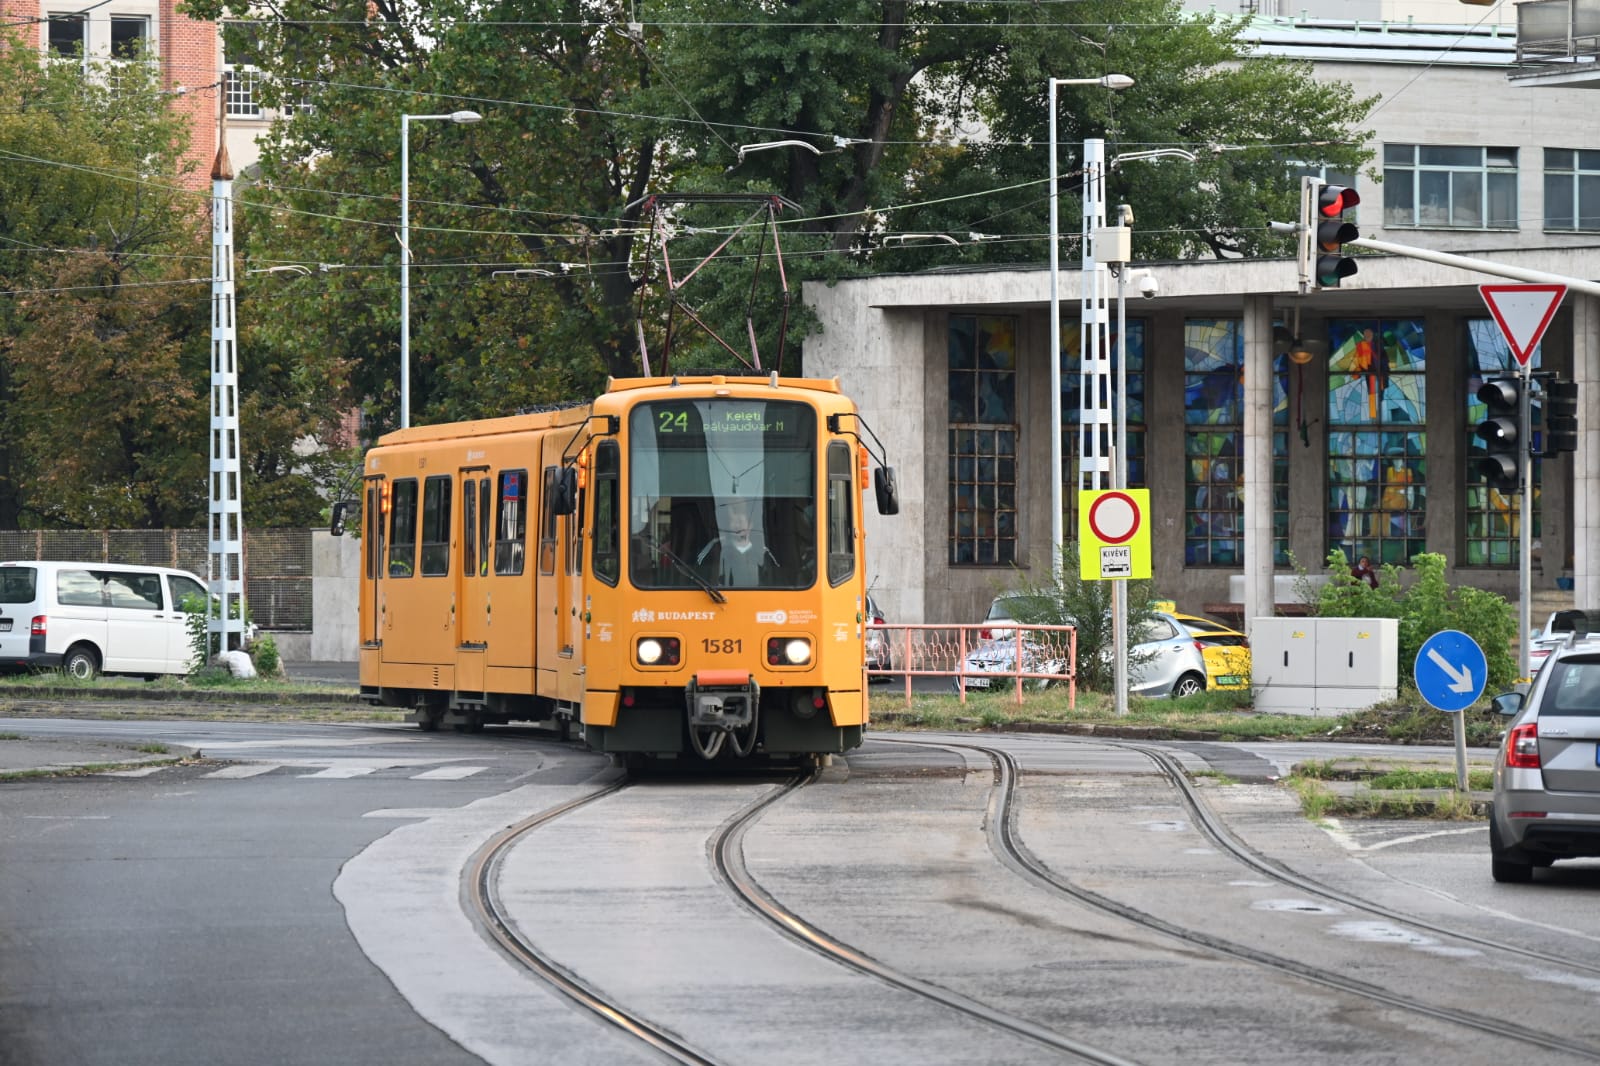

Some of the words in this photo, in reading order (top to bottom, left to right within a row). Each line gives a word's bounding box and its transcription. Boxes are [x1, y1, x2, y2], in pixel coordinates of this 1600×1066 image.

[726, 411, 761, 421] Keleti
[659, 411, 688, 432] 24
[776, 421, 784, 431] M
[658, 611, 715, 620] BUDAPEST
[701, 638, 742, 654] 1581
